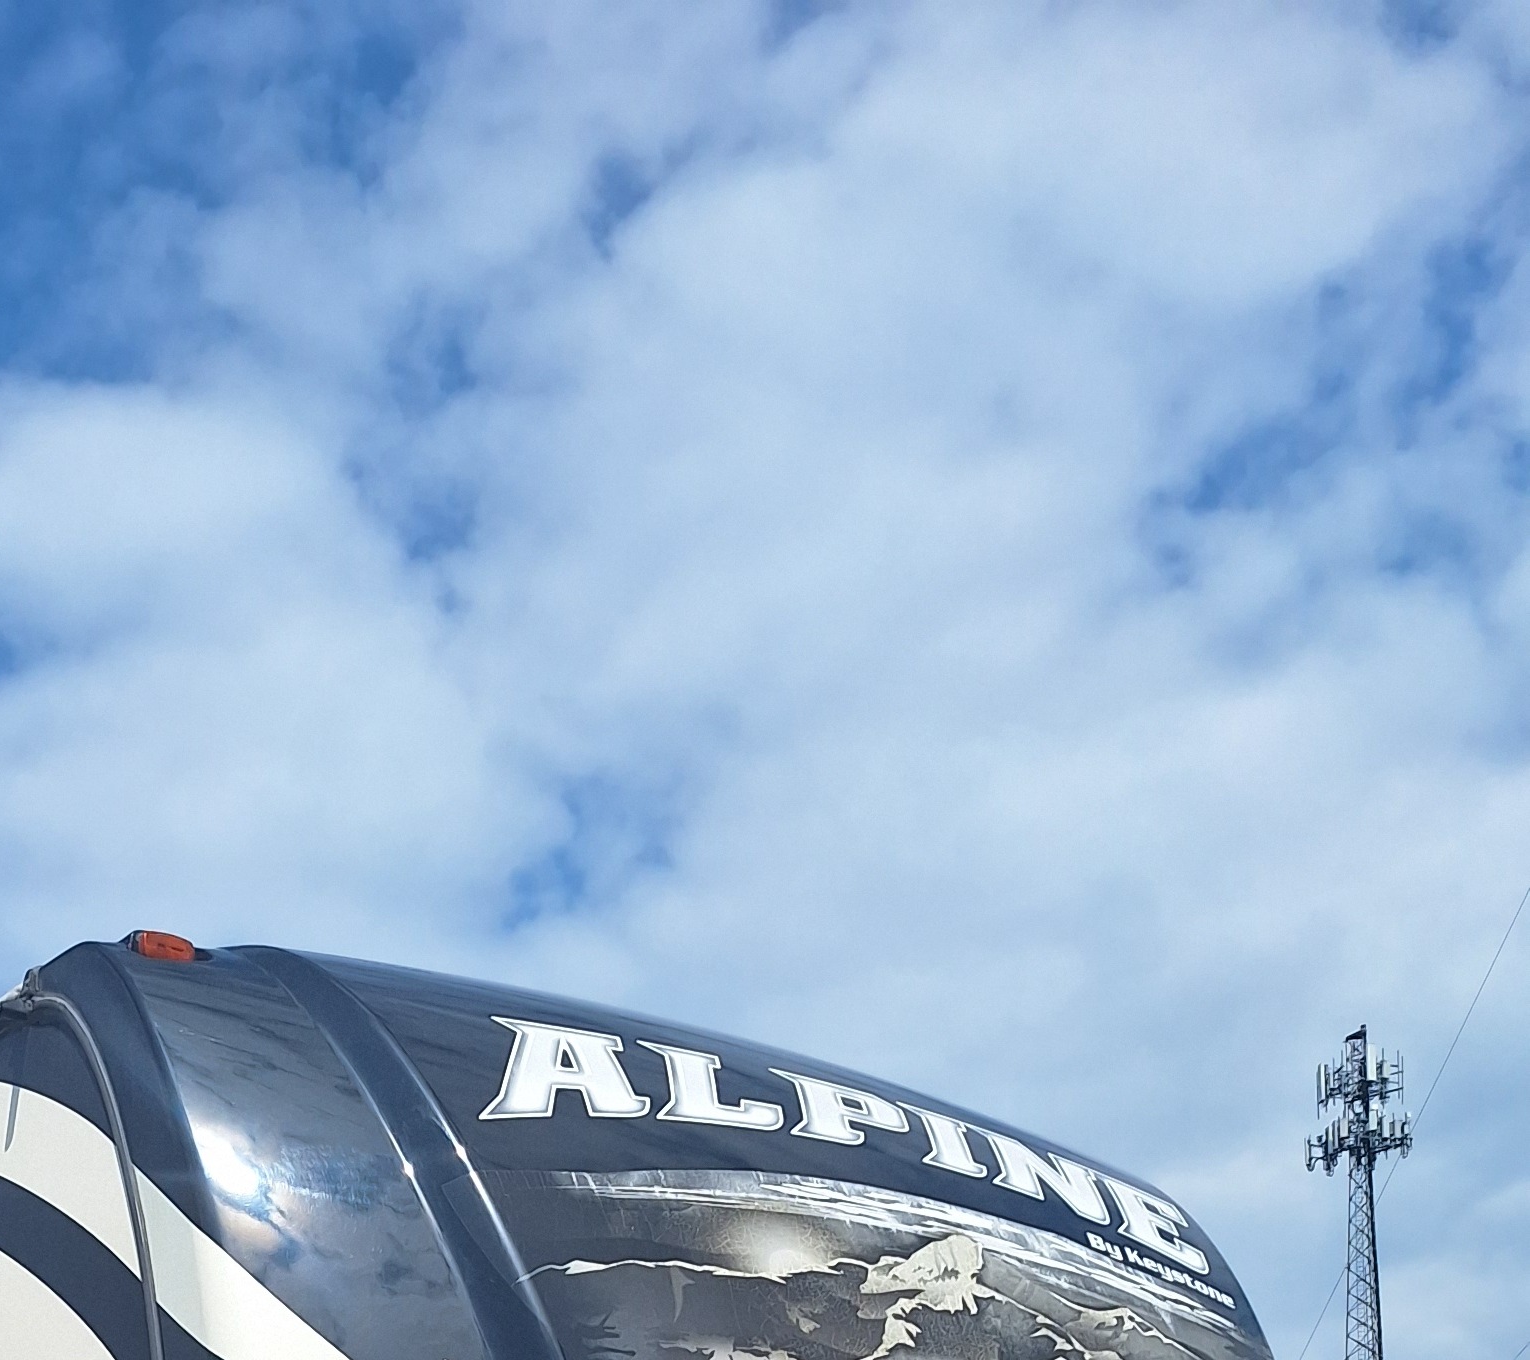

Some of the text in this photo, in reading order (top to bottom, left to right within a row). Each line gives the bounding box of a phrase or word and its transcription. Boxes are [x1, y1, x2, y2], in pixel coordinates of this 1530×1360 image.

[478, 1015, 1211, 1276] ALPINE
[1086, 1231, 1237, 1310] By Keystone
